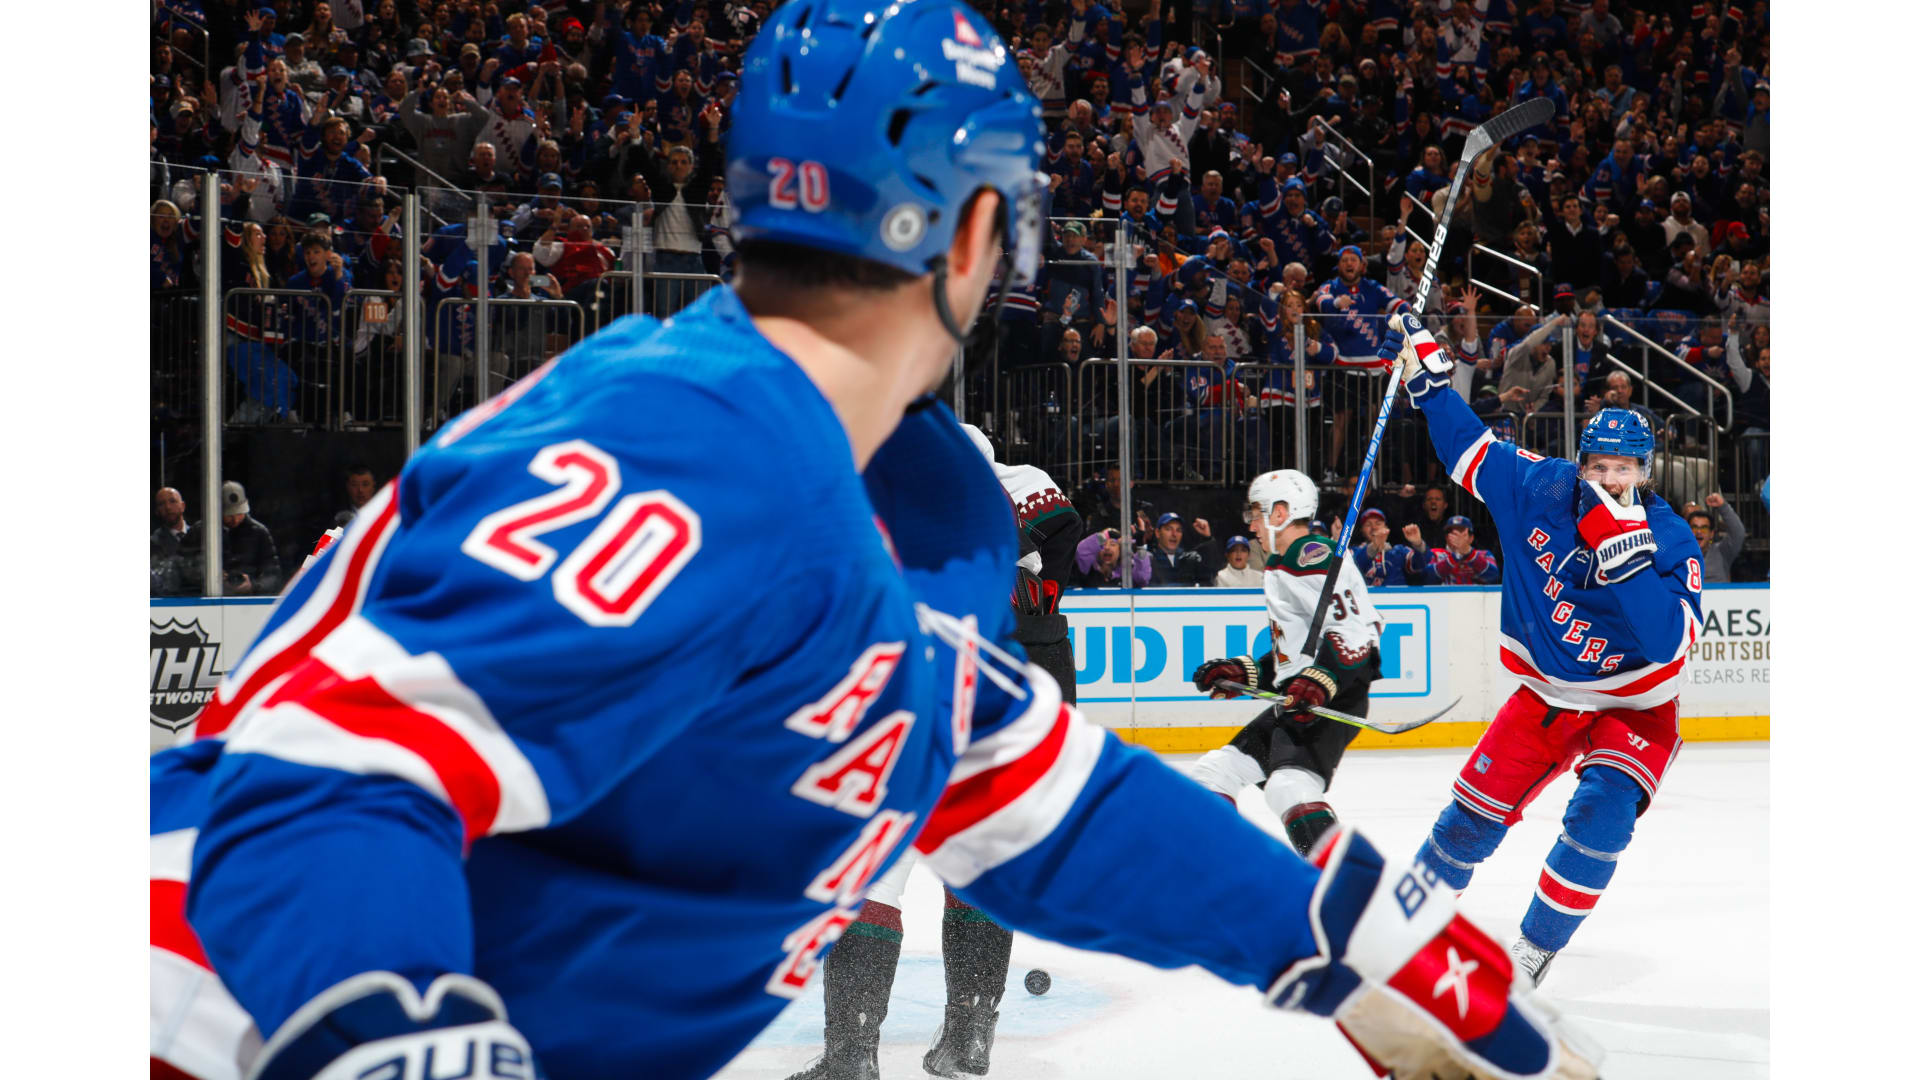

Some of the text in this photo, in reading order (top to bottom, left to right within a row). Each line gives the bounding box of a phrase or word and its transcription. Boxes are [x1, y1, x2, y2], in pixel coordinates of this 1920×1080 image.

[767, 157, 829, 213] 20
[1412, 223, 1448, 314] BAUER
[461, 439, 702, 627] 20
[1527, 527, 1625, 676] RANGERS
[1686, 557, 1701, 593] 8
[1701, 609, 1770, 637] AES
[1067, 622, 1414, 684] UD LIT
[1693, 667, 1770, 685] ESARS RE
